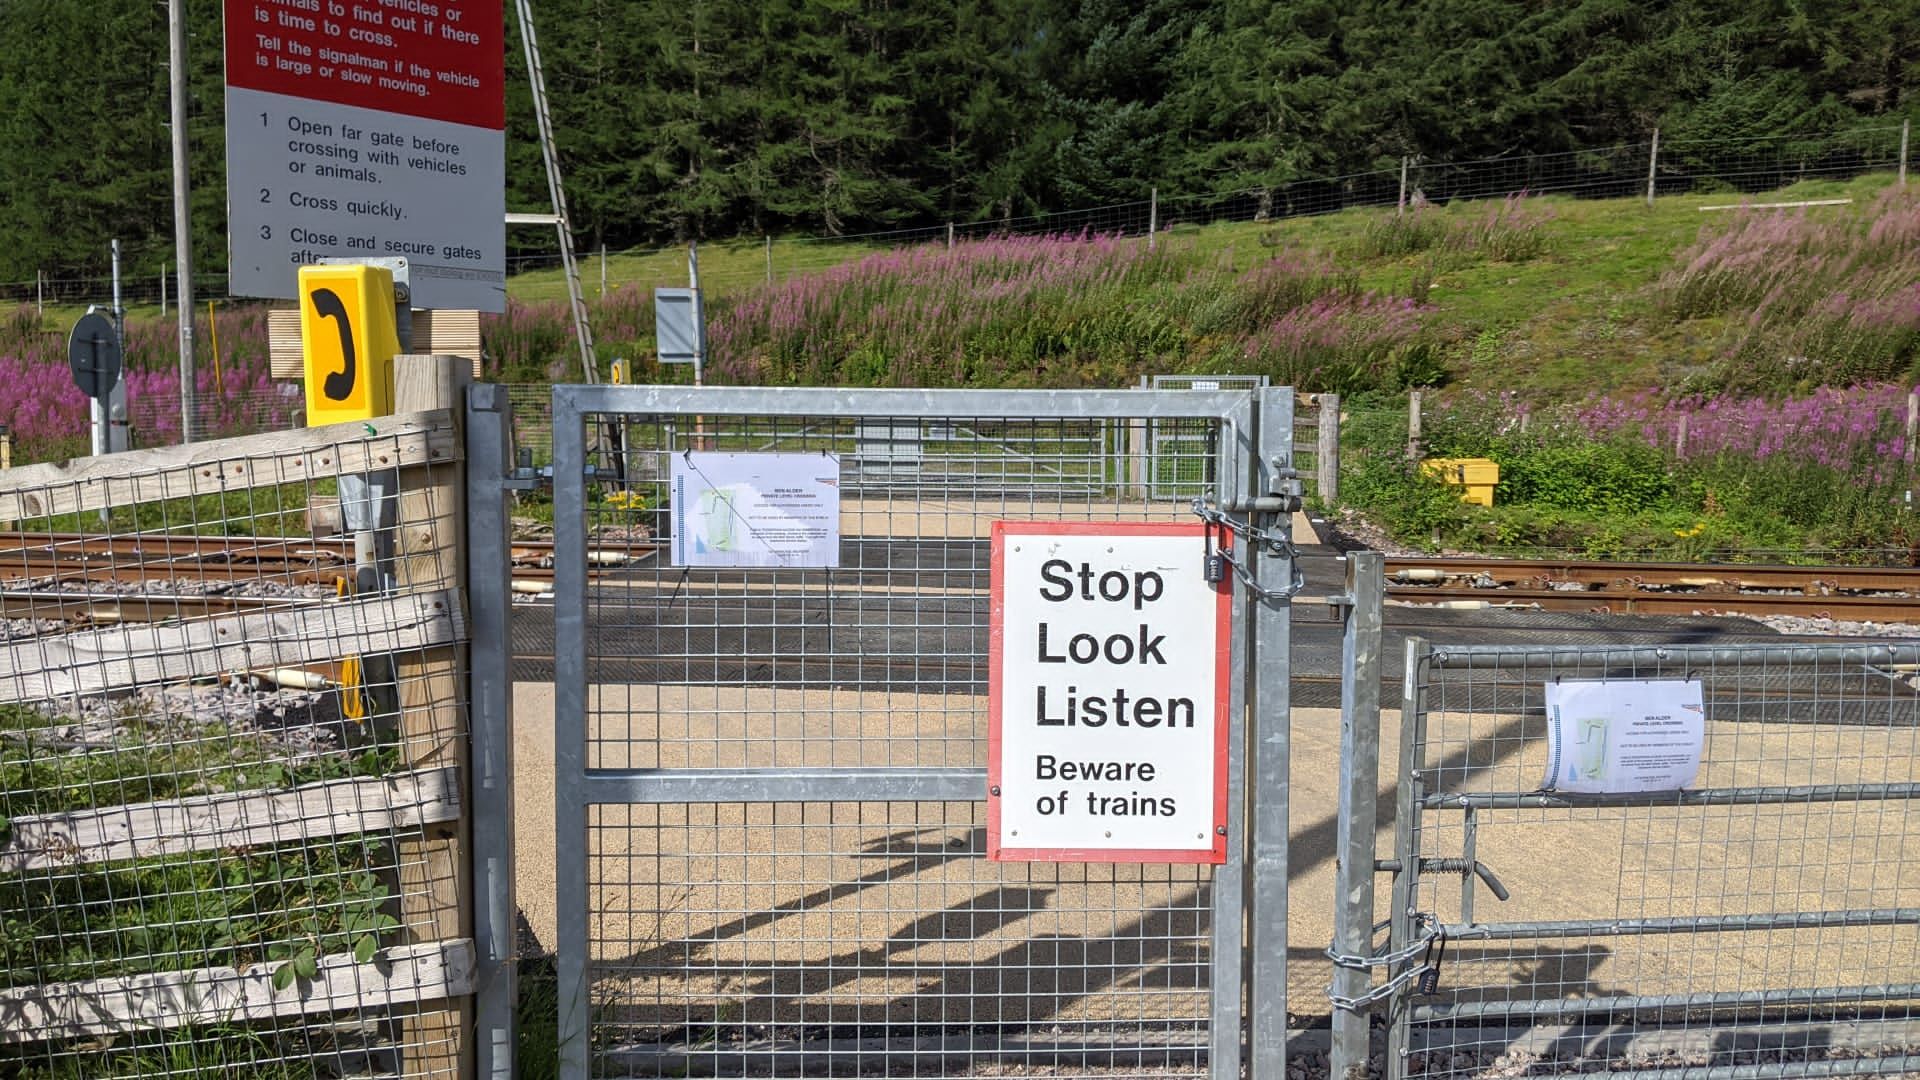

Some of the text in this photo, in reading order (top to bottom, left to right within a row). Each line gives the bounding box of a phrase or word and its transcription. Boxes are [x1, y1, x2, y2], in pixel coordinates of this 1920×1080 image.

[254, 6, 399, 48] is time to cross.
[329, 1, 345, 18] to
[353, 6, 383, 25] find
[391, 15, 417, 33] out
[423, 21, 434, 36] if
[441, 24, 480, 46] there
[446, 9, 462, 23] or
[256, 34, 480, 88] Tell the signalman if the vehicle
[256, 53, 430, 97] is large or slow moving.
[260, 112, 460, 155] 1 Open far gate before
[288, 140, 467, 176] crossing with vehicles
[289, 161, 383, 184] or animals.
[260, 189, 408, 221] 2 Cross quickly.
[260, 226, 482, 261] 3 Close and secure gates
[290, 250, 329, 265] afte
[1039, 559, 1164, 611] Stop
[1038, 622, 1167, 665] Look
[1036, 686, 1194, 728] Listen
[1036, 754, 1155, 782] Beware
[1036, 790, 1176, 817] of trains
